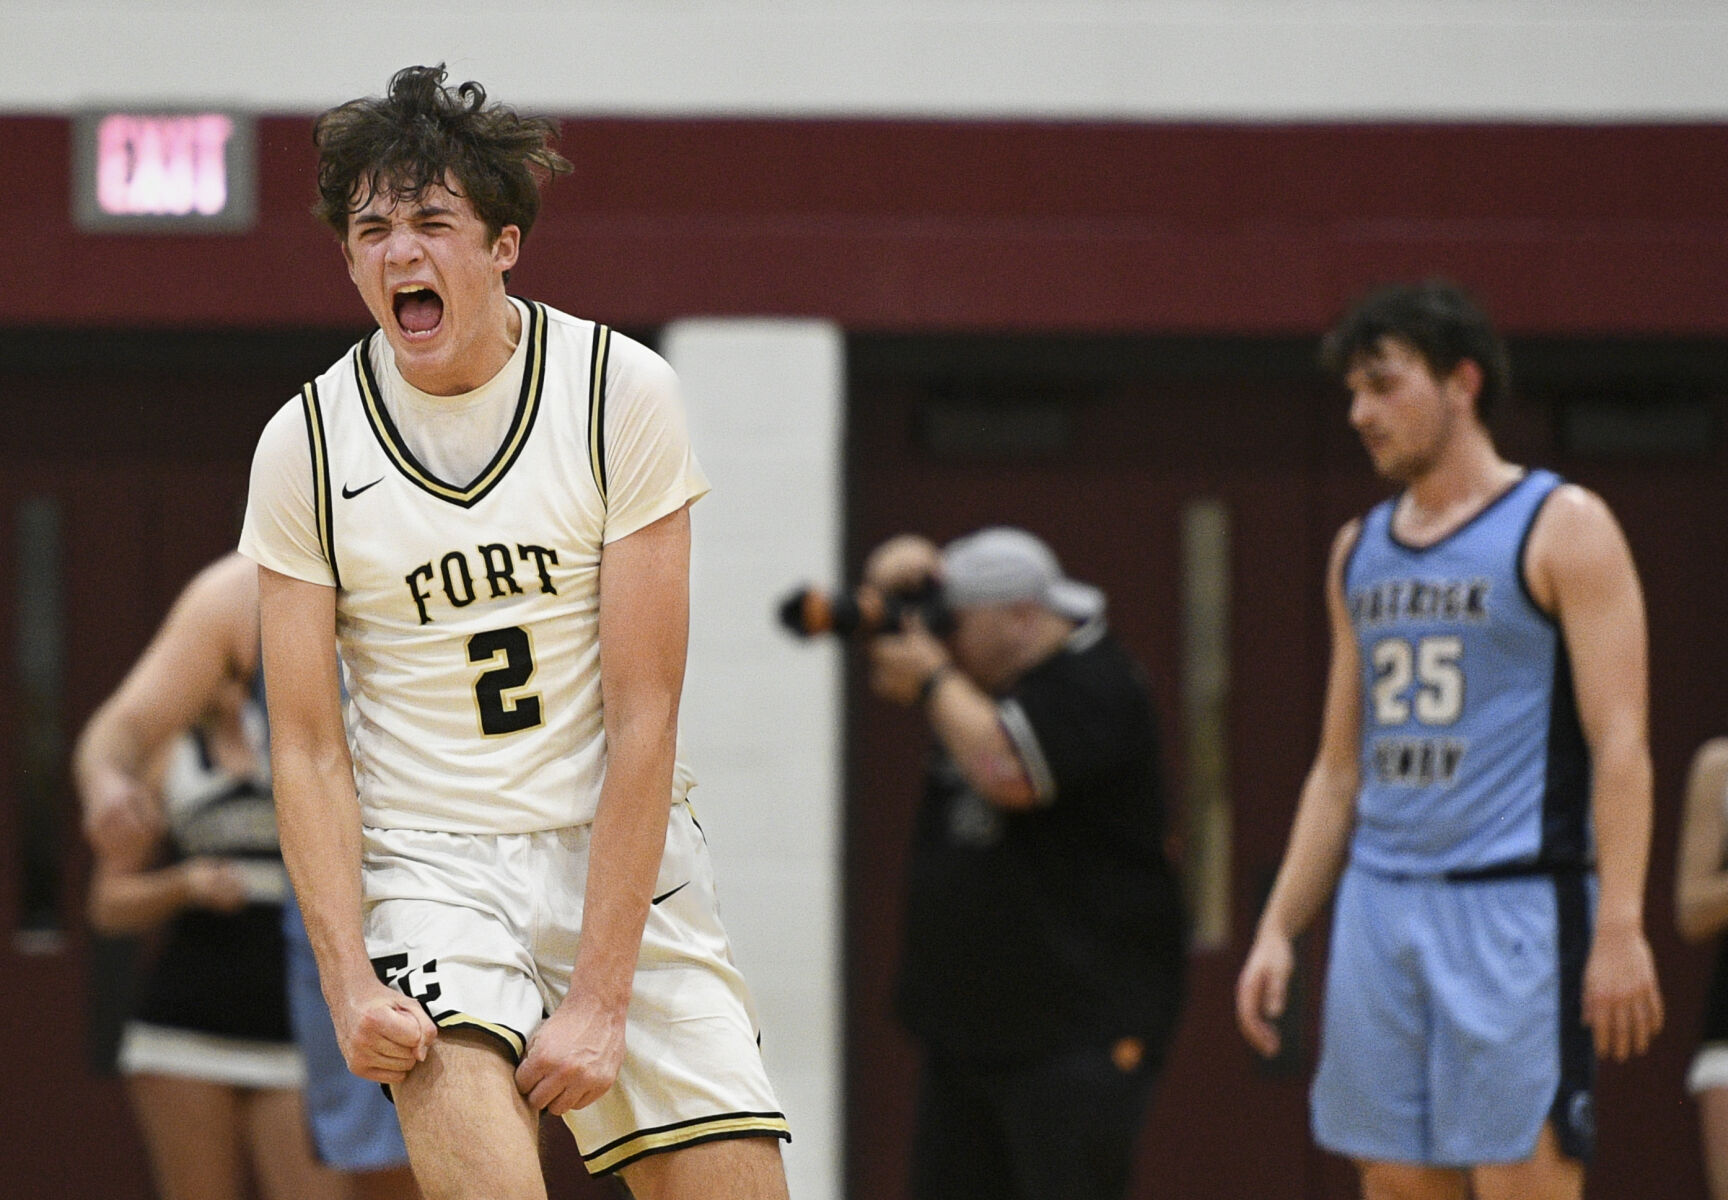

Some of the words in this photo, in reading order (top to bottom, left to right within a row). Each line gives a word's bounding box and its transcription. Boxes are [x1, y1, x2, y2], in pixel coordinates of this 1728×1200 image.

[404, 542, 560, 626] FORT
[465, 625, 546, 740] 2
[1372, 635, 1466, 726] 25
